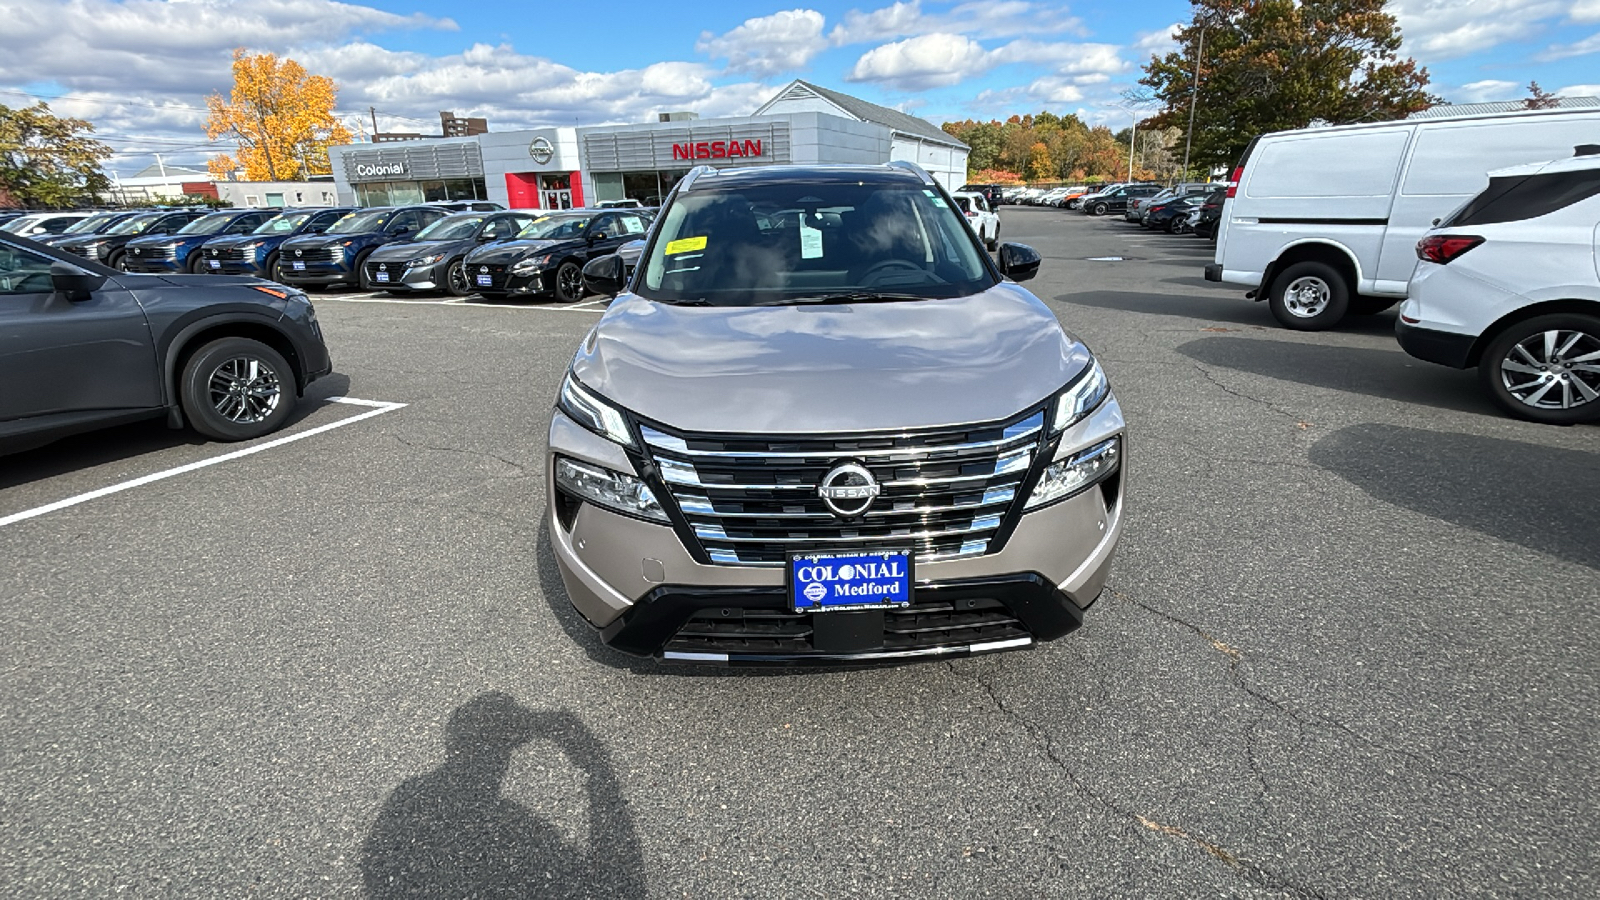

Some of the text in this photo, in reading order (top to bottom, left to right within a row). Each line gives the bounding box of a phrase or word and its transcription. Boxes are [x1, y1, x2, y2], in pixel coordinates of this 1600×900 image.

[672, 139, 763, 160] NISSAN
[357, 162, 404, 176] Colonial
[819, 487, 879, 498] NISSAN
[797, 562, 904, 582] COLONIAL
[834, 581, 900, 597] Medford
